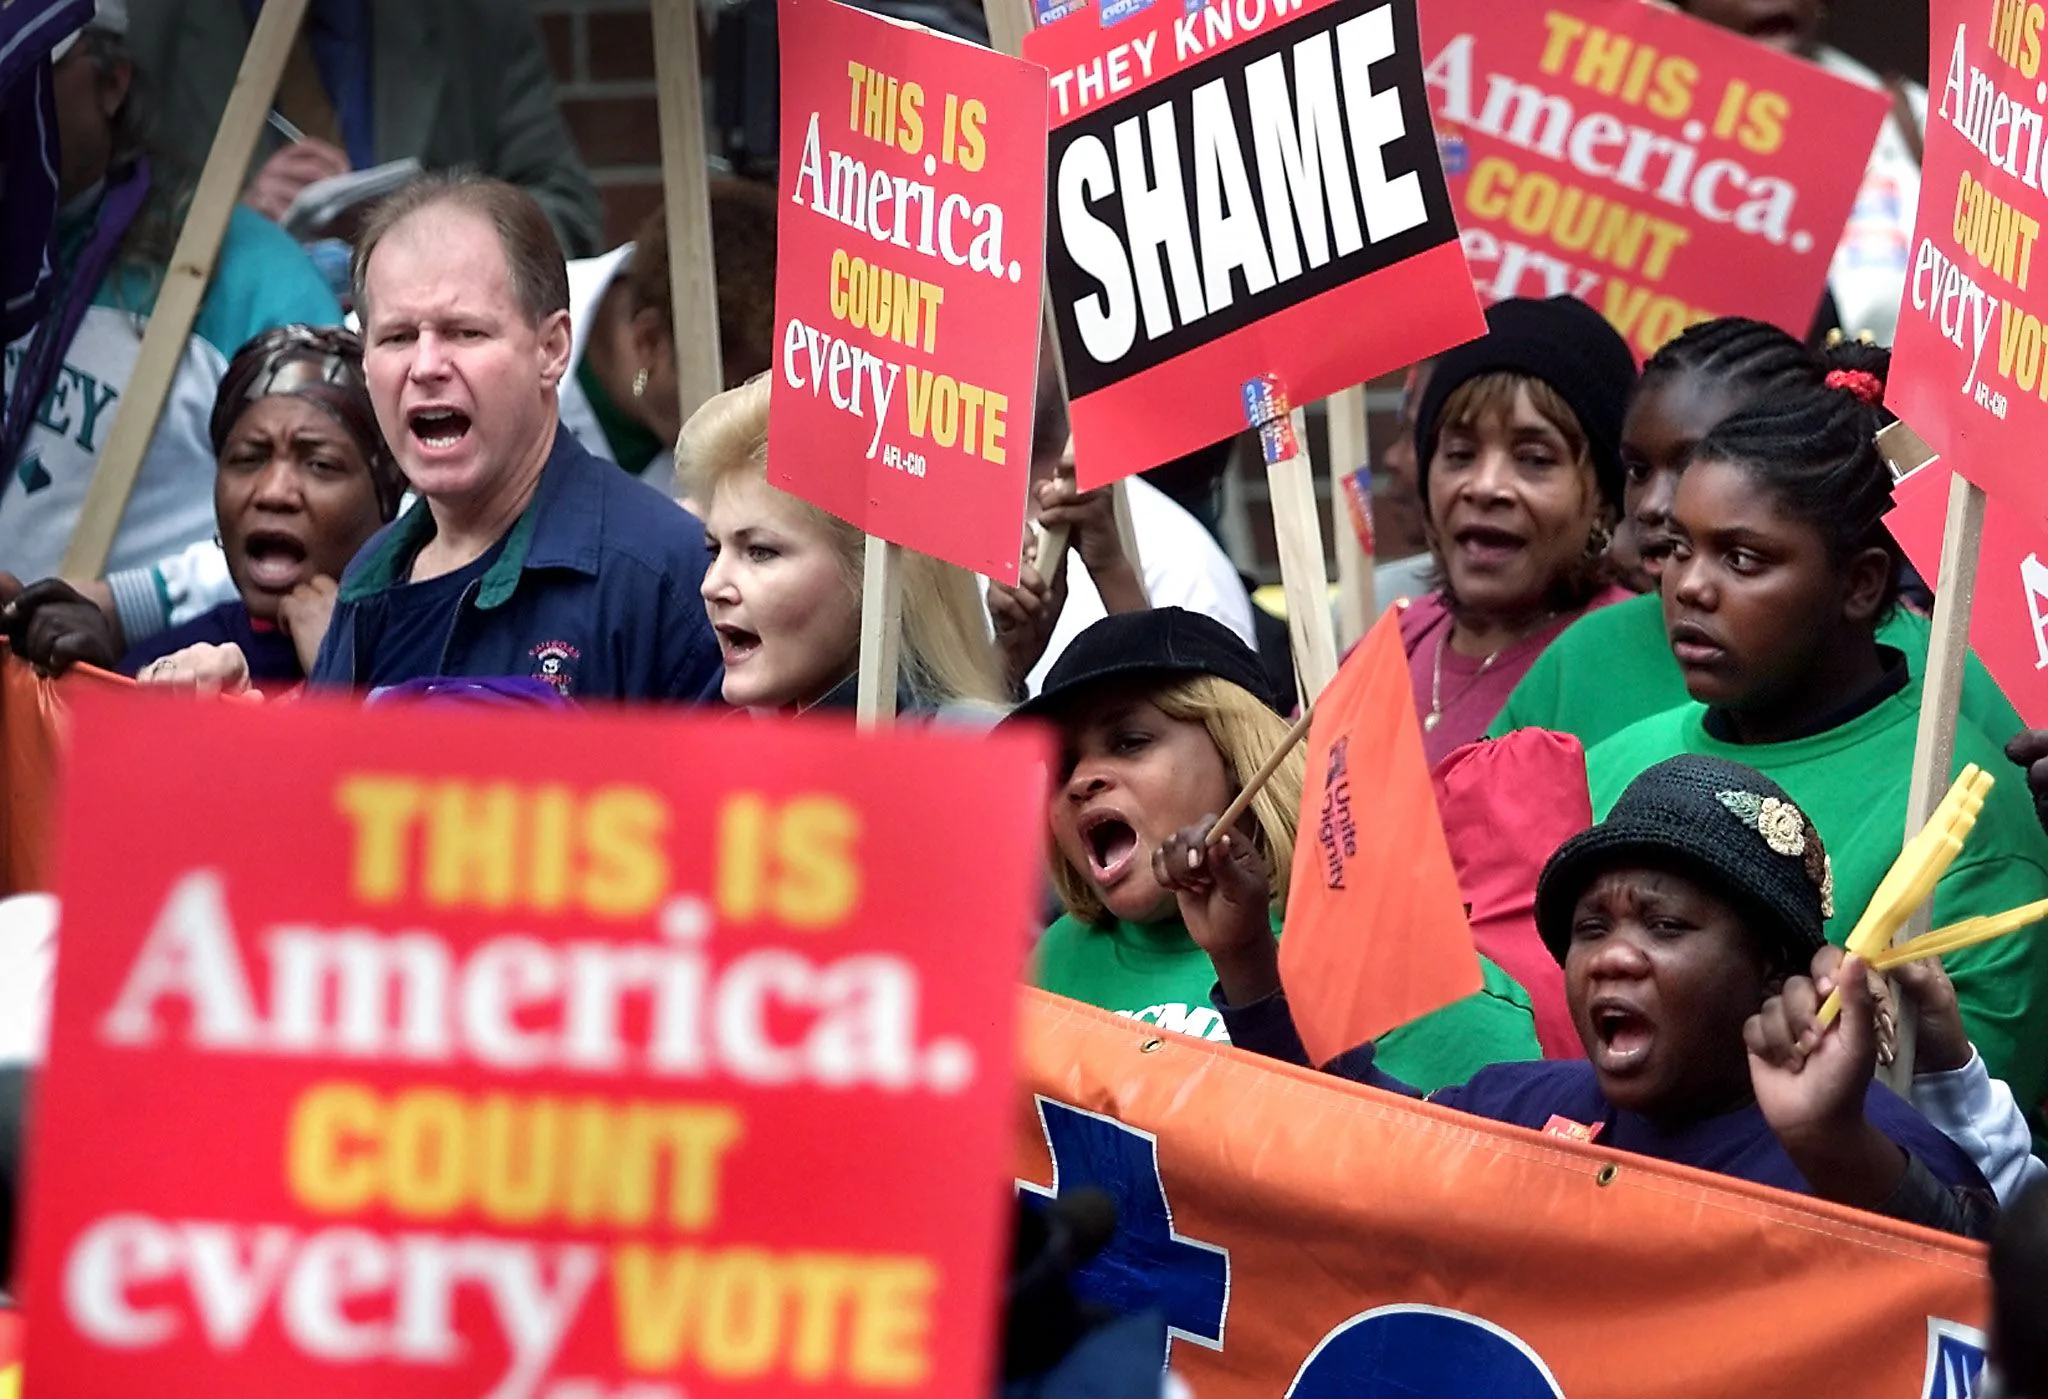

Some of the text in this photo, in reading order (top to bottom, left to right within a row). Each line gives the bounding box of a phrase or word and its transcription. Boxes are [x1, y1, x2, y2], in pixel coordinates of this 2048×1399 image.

[847, 60, 988, 173] THIS IS
[1050, 30, 1158, 117] THEY
[1423, 33, 1814, 253] America.
[1539, 11, 1791, 154] THIS IS
[1938, 23, 2048, 200] Ameri
[792, 112, 1022, 283] America.
[1057, 3, 1428, 363] SHAME
[1464, 157, 1691, 281] COUNT
[1953, 170, 2040, 292] COUNT
[829, 248, 945, 355] COUNT
[1912, 237, 1998, 394] every
[783, 318, 1009, 466] every VOTE
[883, 443, 926, 478] AFL-CIO
[337, 772, 863, 926] THIS IS
[1334, 781, 1358, 858] Unite
[97, 866, 977, 1093] America.
[284, 1080, 746, 1230] COUNT
[62, 1212, 940, 1399] every VOTE
